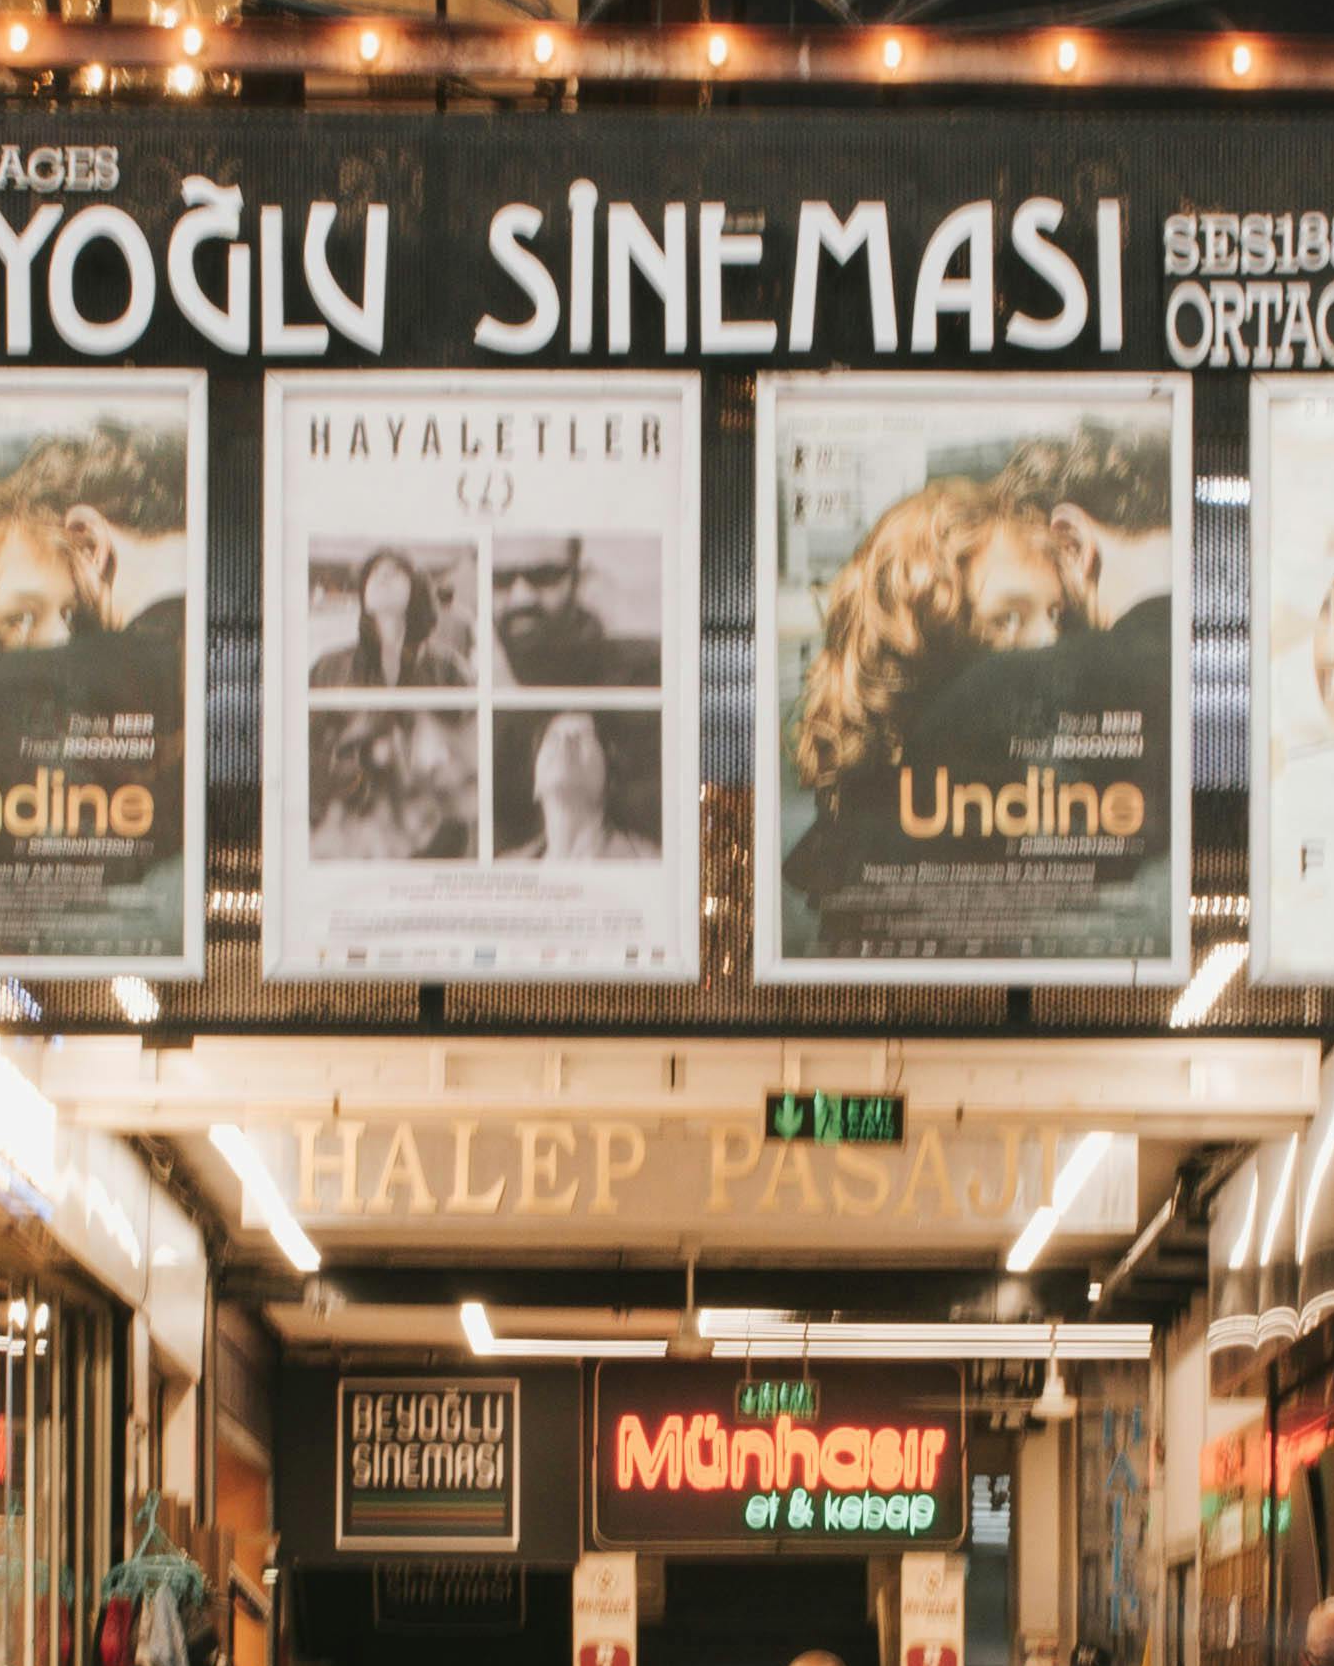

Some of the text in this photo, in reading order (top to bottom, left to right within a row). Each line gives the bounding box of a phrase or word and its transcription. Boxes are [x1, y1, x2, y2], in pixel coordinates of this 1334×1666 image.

[474, 177, 1124, 355] SİNEMASI
[309, 413, 663, 461] HAYALETLER
[900, 764, 1145, 839] Undine
[293, 1118, 649, 1217] HALEP
[351, 1386, 505, 1443] BEYOĞLU
[617, 1413, 947, 1492] Münhasır
[824, 1489, 936, 1537] kebap
